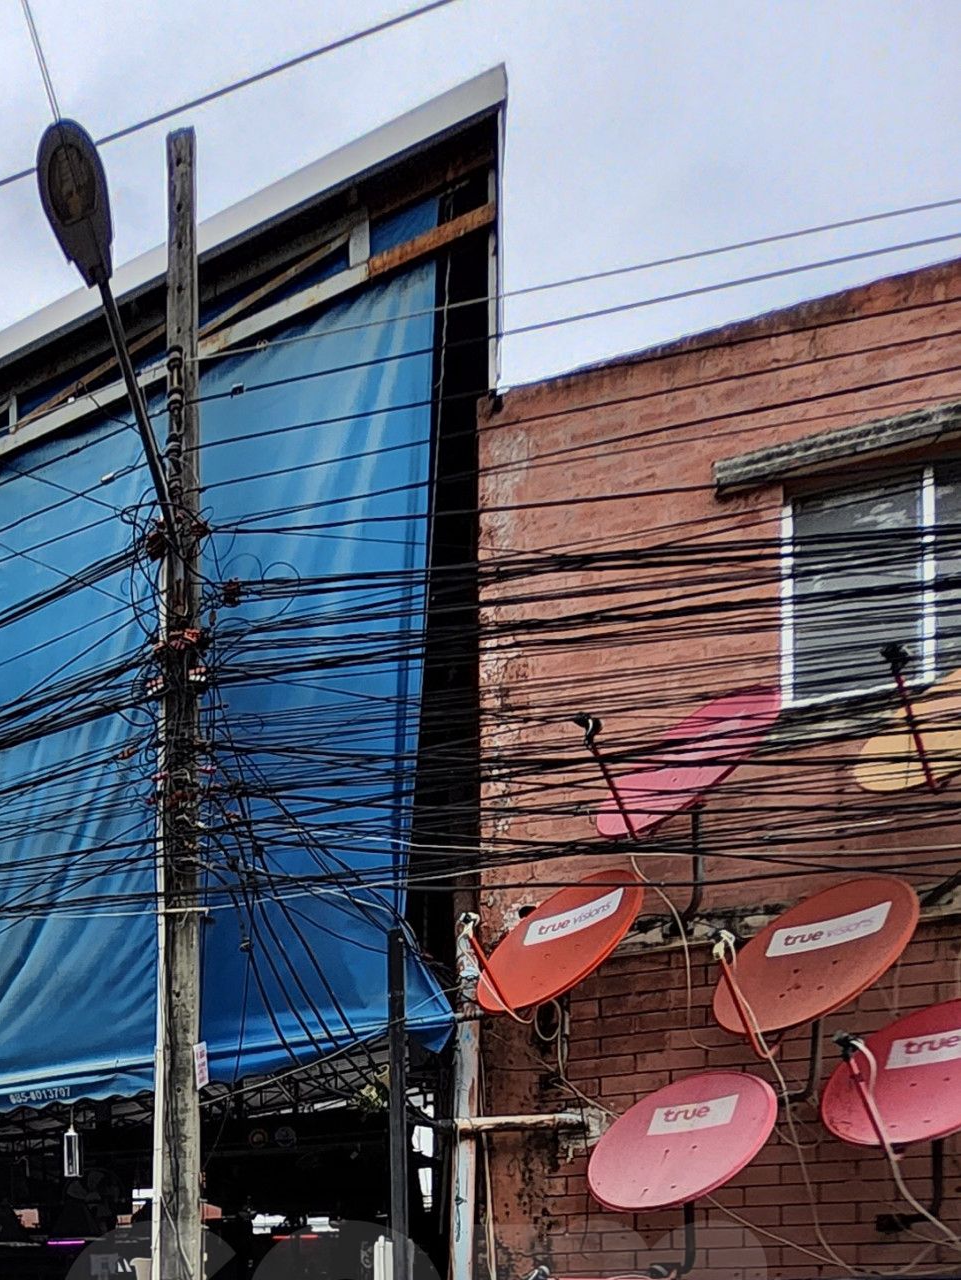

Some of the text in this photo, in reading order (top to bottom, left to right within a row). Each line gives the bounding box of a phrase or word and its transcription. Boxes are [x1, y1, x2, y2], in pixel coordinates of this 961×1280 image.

[537, 901, 613, 935] true visions
[783, 930, 825, 947] true
[903, 1035, 961, 1055] true
[663, 1105, 711, 1123] true
